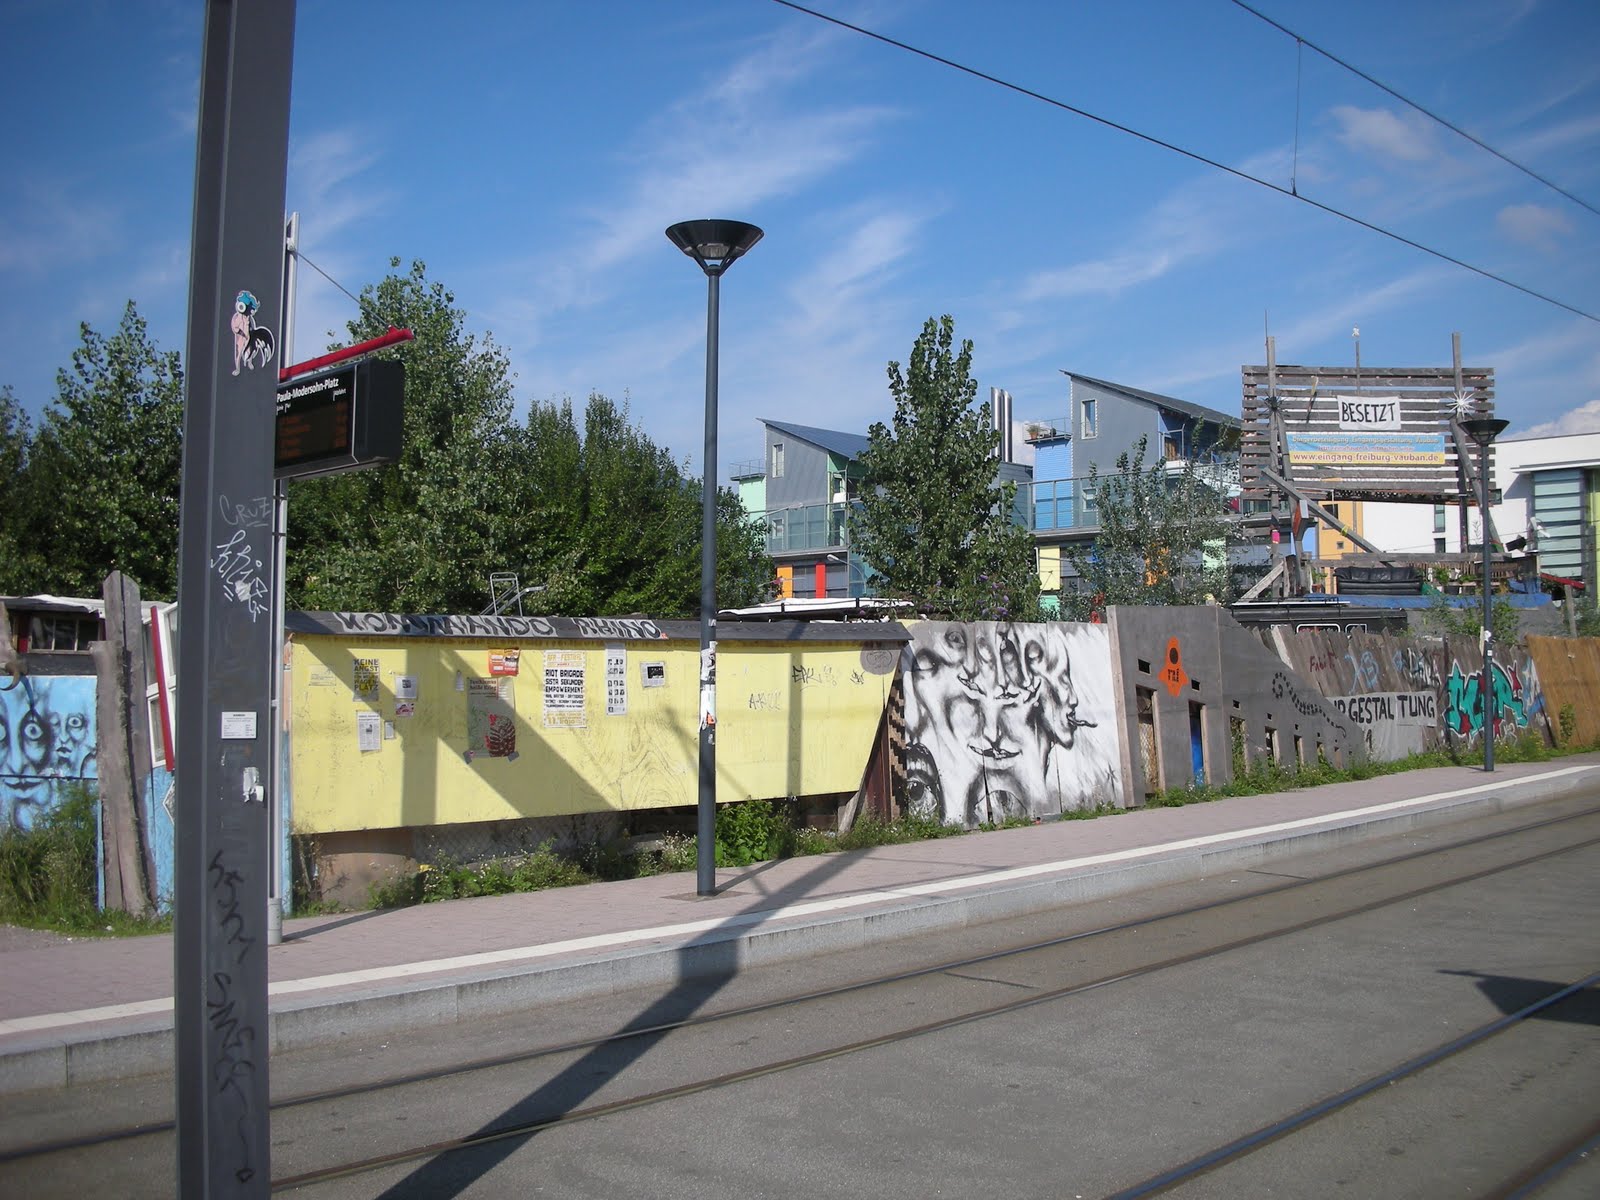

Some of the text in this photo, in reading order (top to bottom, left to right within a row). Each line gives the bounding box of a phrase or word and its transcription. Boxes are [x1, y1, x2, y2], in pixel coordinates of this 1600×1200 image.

[276, 378, 339, 402] Paula-Modersohn-Platz
[1341, 401, 1395, 422] BESETZT
[1293, 452, 1439, 463] www.eingang-freiburg-vauban.de
[334, 612, 662, 639] KOMMANDO RHINO
[546, 669, 583, 678] RIOT BRIGADE
